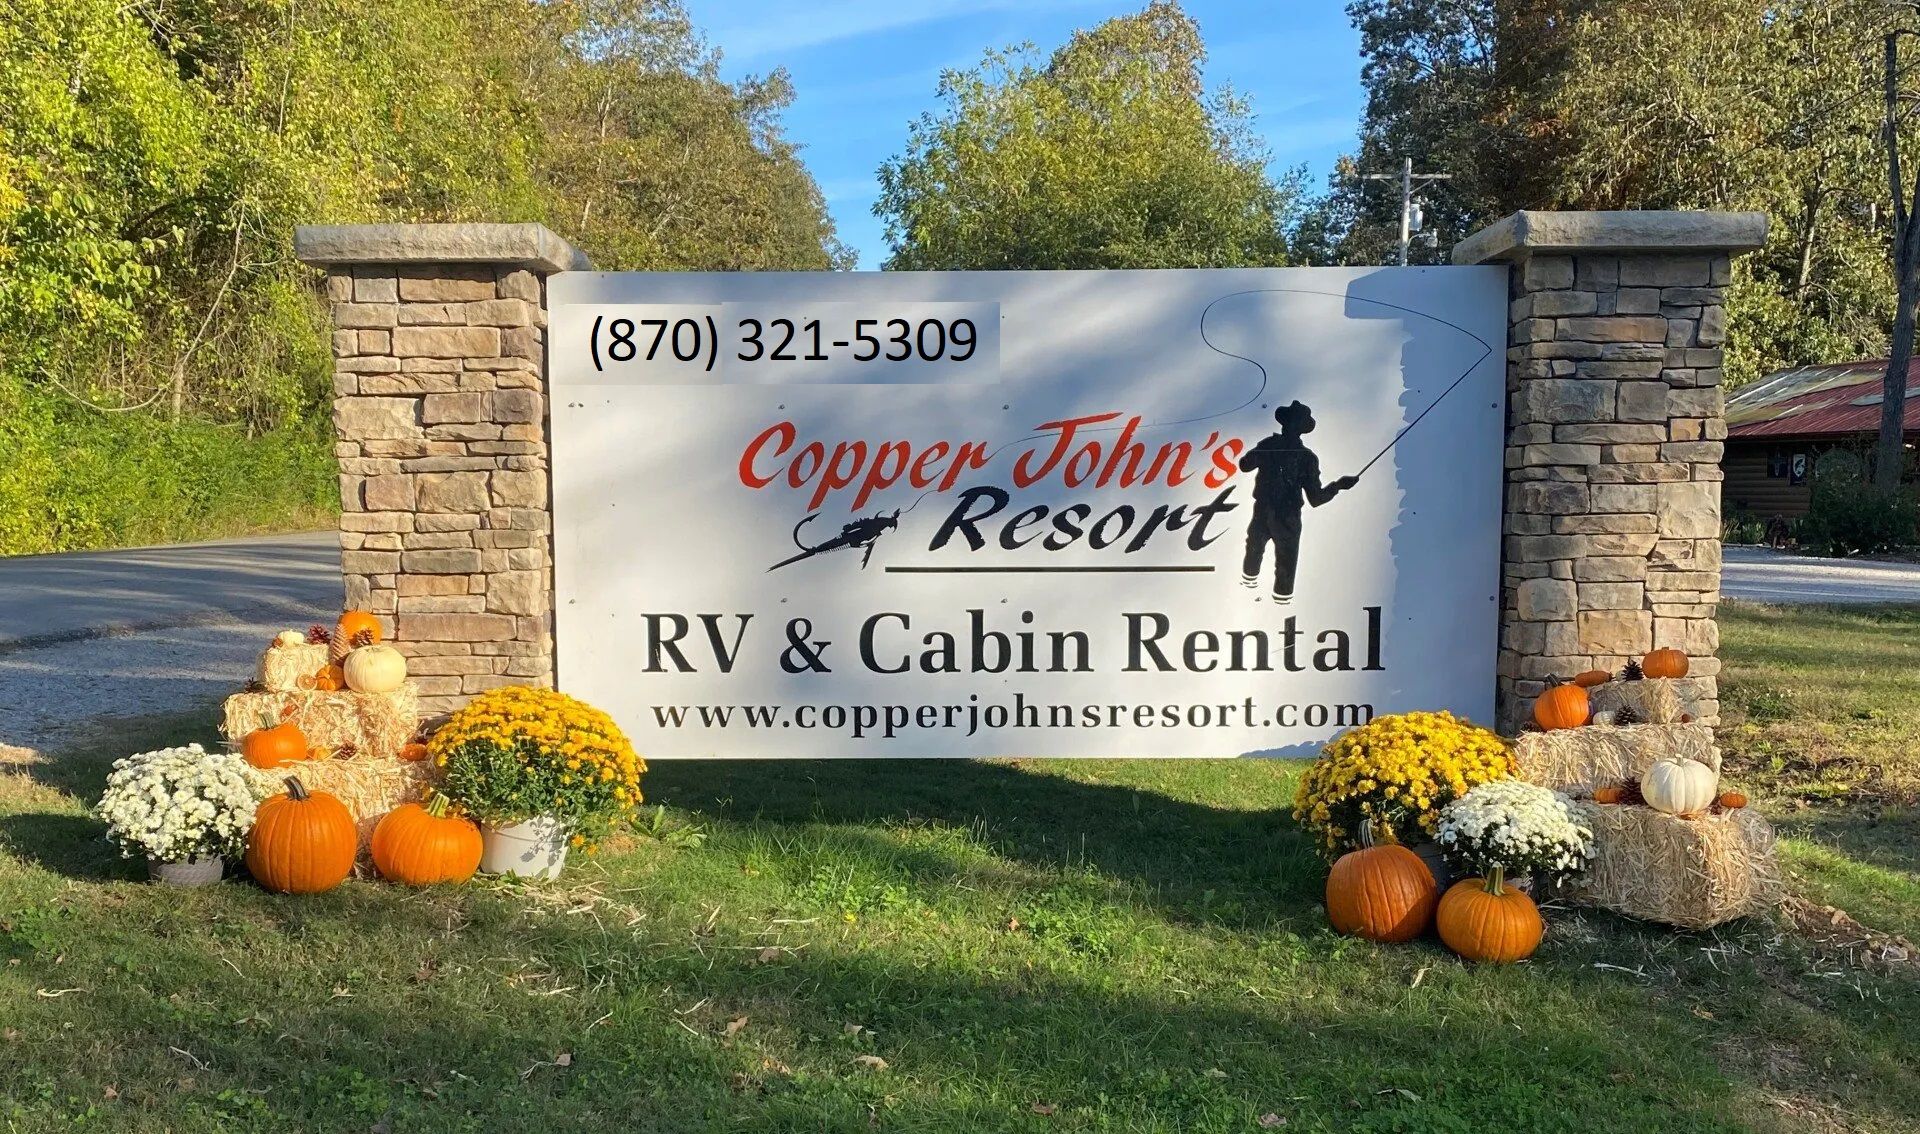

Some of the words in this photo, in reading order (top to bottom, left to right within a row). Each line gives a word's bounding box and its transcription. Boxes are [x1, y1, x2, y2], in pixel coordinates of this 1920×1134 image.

[738, 420, 990, 513] Copper
[1012, 411, 1244, 489] John's
[927, 484, 1240, 554] Resort
[640, 612, 755, 674] RV
[779, 616, 832, 674] &
[858, 608, 1095, 674] Cabin
[1120, 605, 1387, 673] Rental
[650, 692, 1375, 739] www.copperjohnsresort.com
